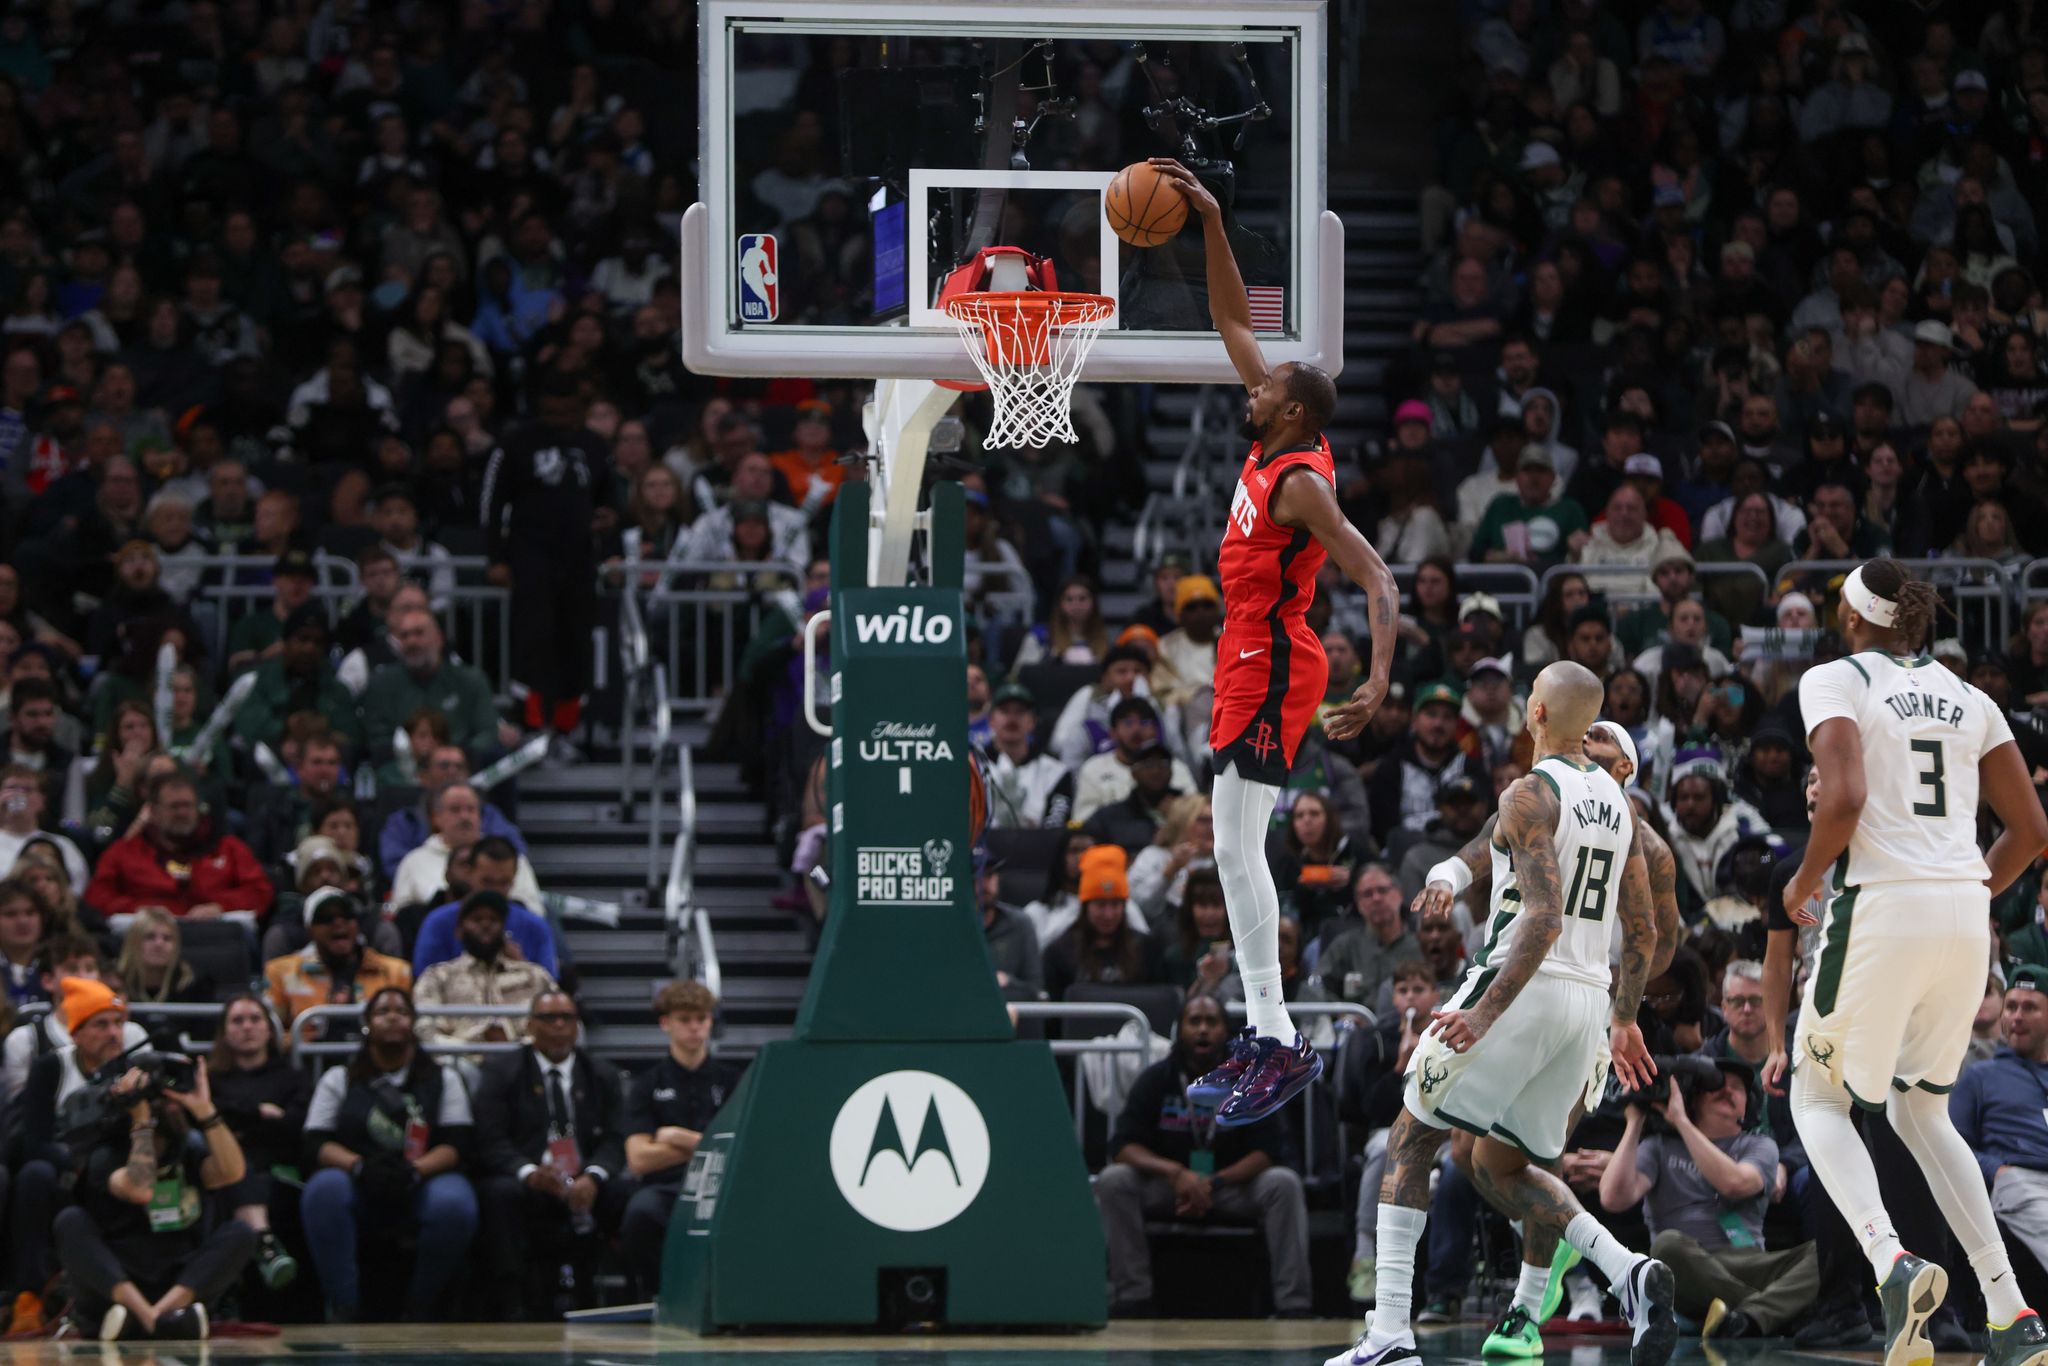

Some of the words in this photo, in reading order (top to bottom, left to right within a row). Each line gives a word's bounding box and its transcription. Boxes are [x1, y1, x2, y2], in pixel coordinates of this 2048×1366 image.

[745, 302, 764, 316] NBA
[855, 604, 953, 645] wilo
[1884, 691, 1964, 729] TURNER
[871, 721, 936, 740] Michelob
[859, 740, 954, 762] ULTRA
[1910, 738, 1947, 817] 3
[1572, 798, 1622, 835] KUZMA
[857, 852, 923, 877] BUCKS
[857, 876, 898, 900] PRO
[901, 876, 955, 900] SHOP
[1563, 845, 1615, 922] 18
